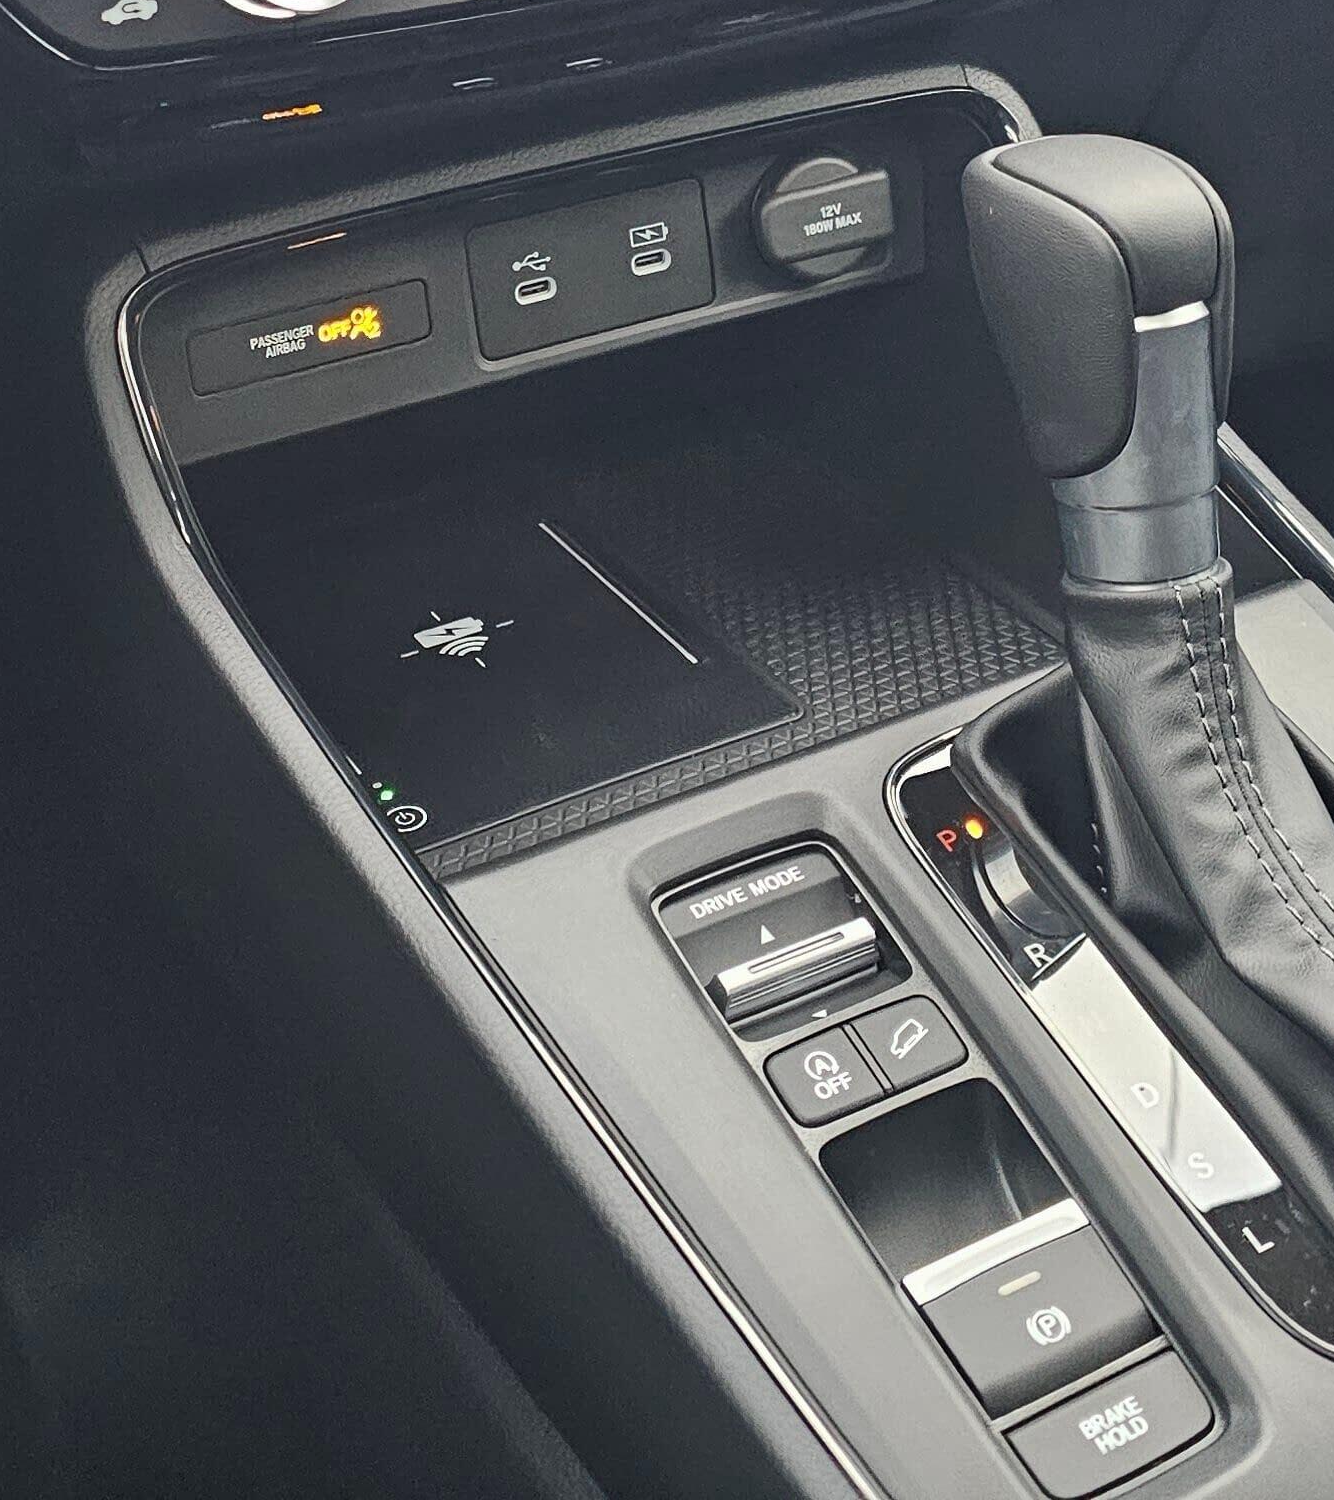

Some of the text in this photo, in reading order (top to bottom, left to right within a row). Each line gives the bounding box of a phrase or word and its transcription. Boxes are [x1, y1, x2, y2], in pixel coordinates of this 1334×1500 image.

[802, 211, 863, 237] 180W MAX
[820, 202, 842, 219] 12V
[249, 324, 315, 351] PASSENGER
[318, 318, 353, 343] OFF
[265, 338, 307, 359] AIRBAG
[935, 828, 958, 853] P
[689, 865, 806, 921] DRIVE MODE
[1023, 942, 1054, 969] R
[813, 1071, 853, 1101] OFF
[1130, 1082, 1161, 1109] D
[1187, 1152, 1216, 1179] S
[1241, 1226, 1276, 1254] L
[1078, 1395, 1144, 1440] BRAKE
[1093, 1414, 1150, 1456] HOLD
